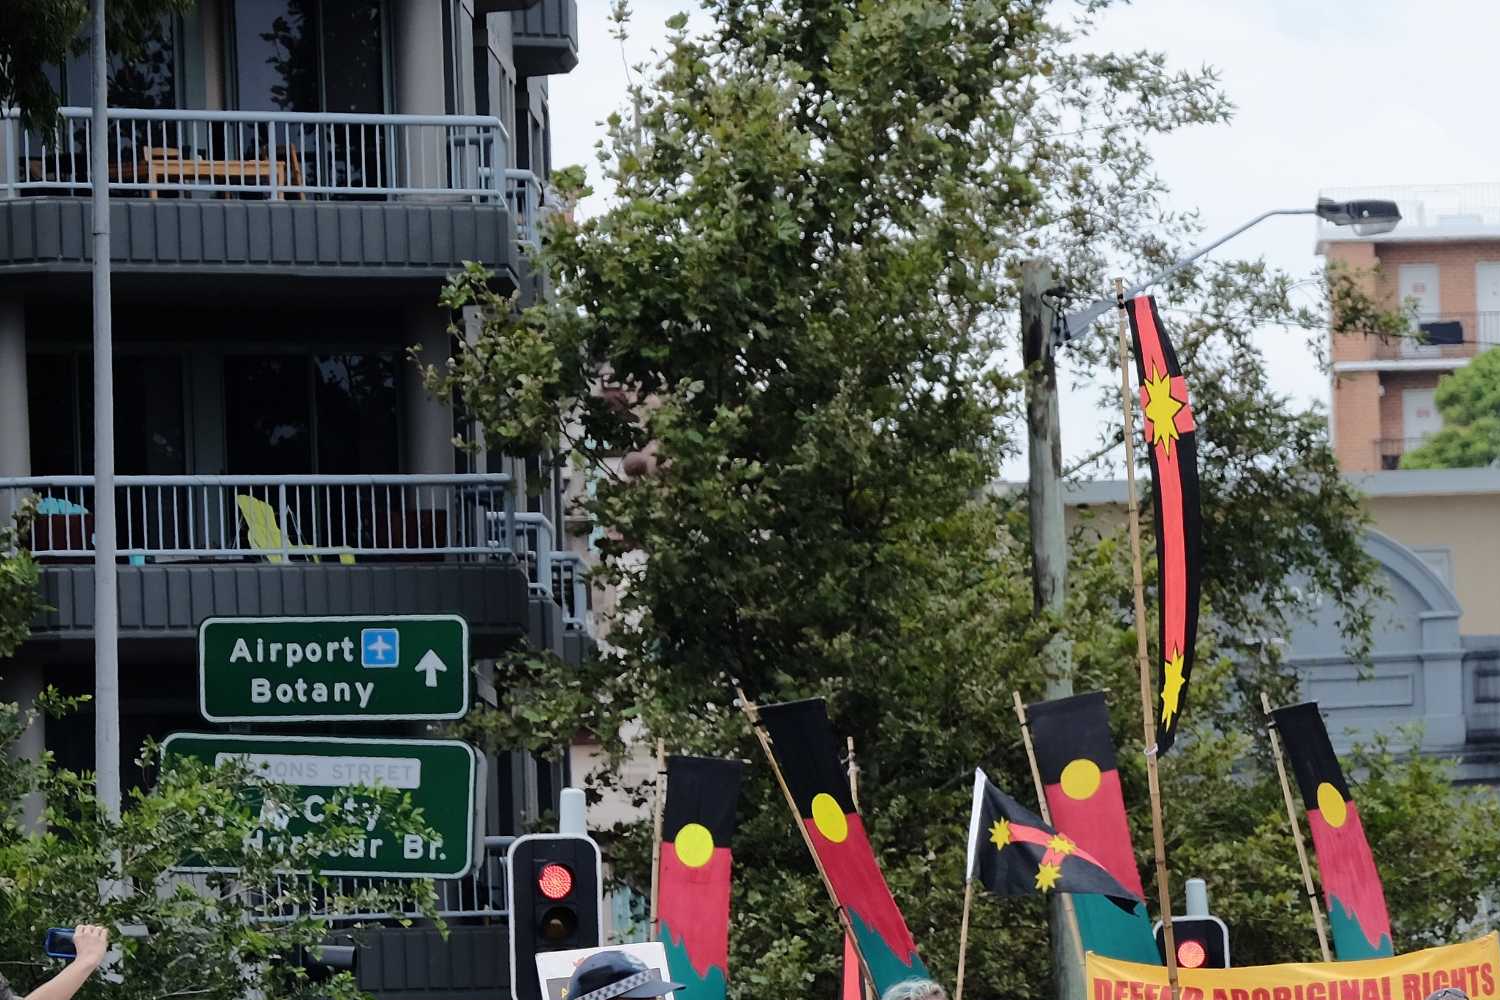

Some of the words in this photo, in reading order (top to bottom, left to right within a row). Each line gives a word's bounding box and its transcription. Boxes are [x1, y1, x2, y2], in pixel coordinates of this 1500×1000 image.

[229, 638, 355, 667] Airport
[251, 677, 375, 708] Botany
[331, 762, 414, 781] STREET
[403, 834, 447, 860] Br.
